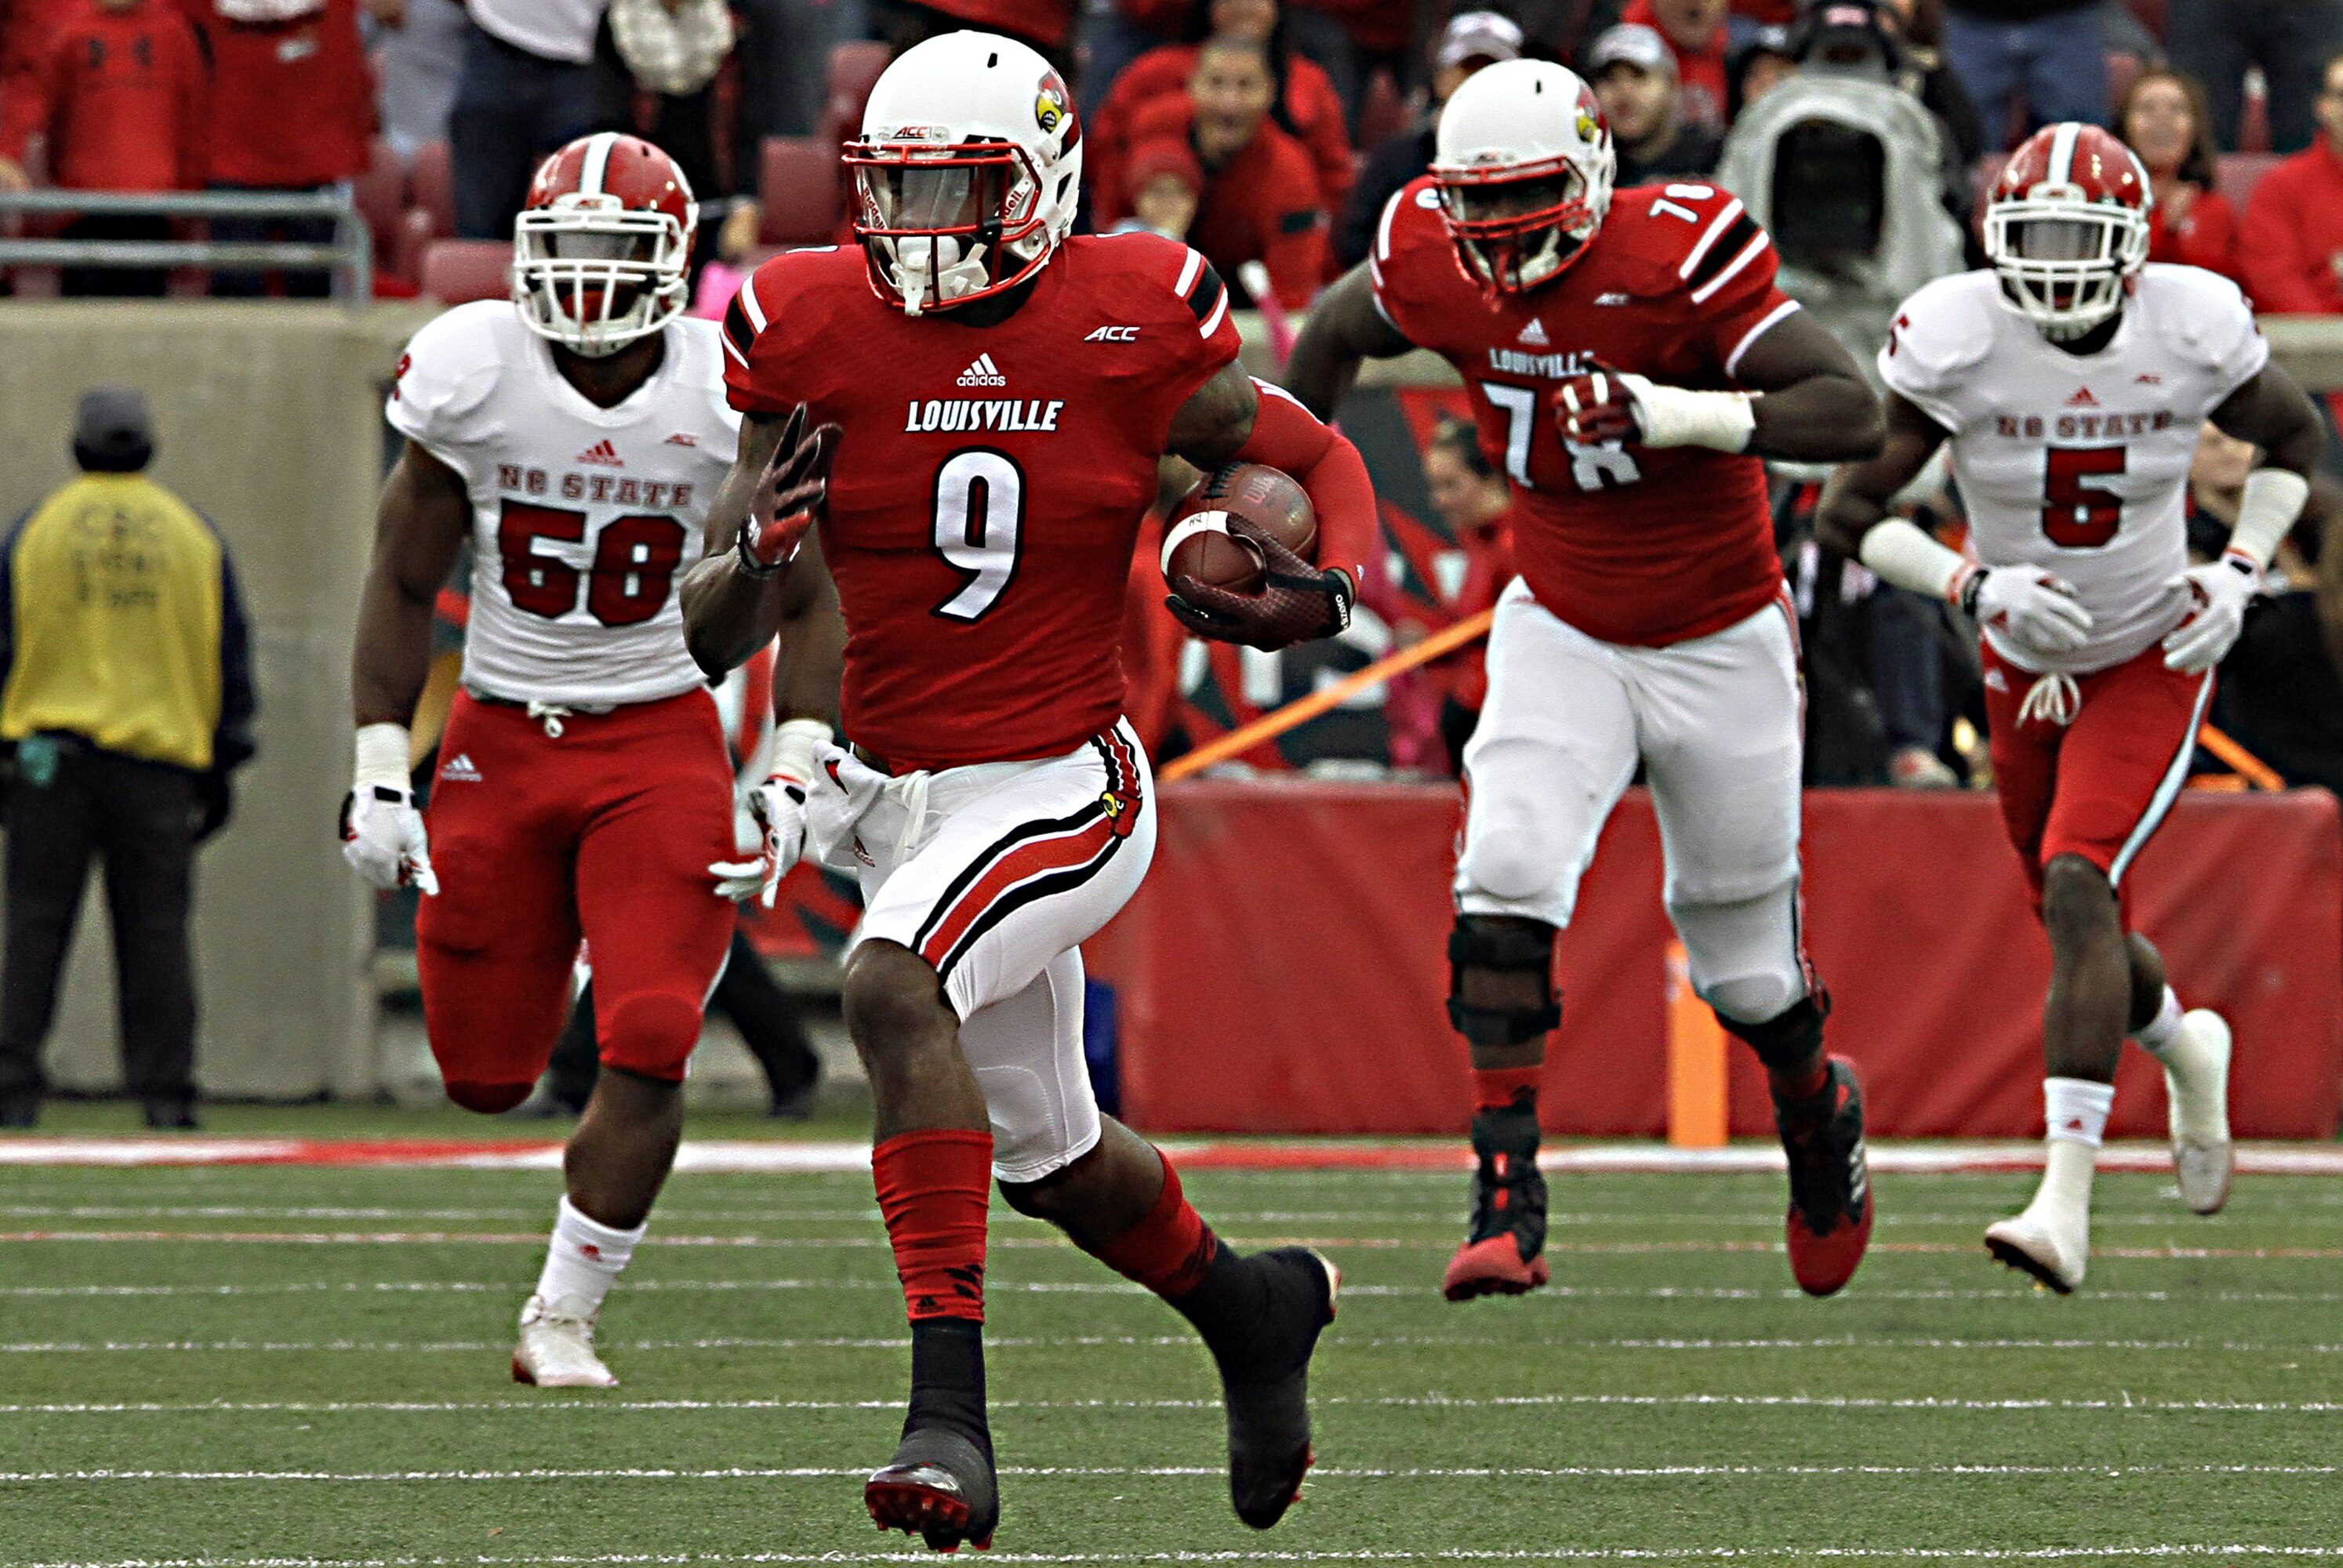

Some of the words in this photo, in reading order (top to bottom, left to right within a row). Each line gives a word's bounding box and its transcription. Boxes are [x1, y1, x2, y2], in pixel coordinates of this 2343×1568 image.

[892, 125, 928, 139] ACC
[1084, 325, 1141, 344] ACC
[956, 374, 1007, 387] adidas
[903, 398, 1066, 432] LOUISVILLE
[561, 473, 693, 508] STATE
[2042, 445, 2127, 547] 5
[929, 445, 1026, 623] 9
